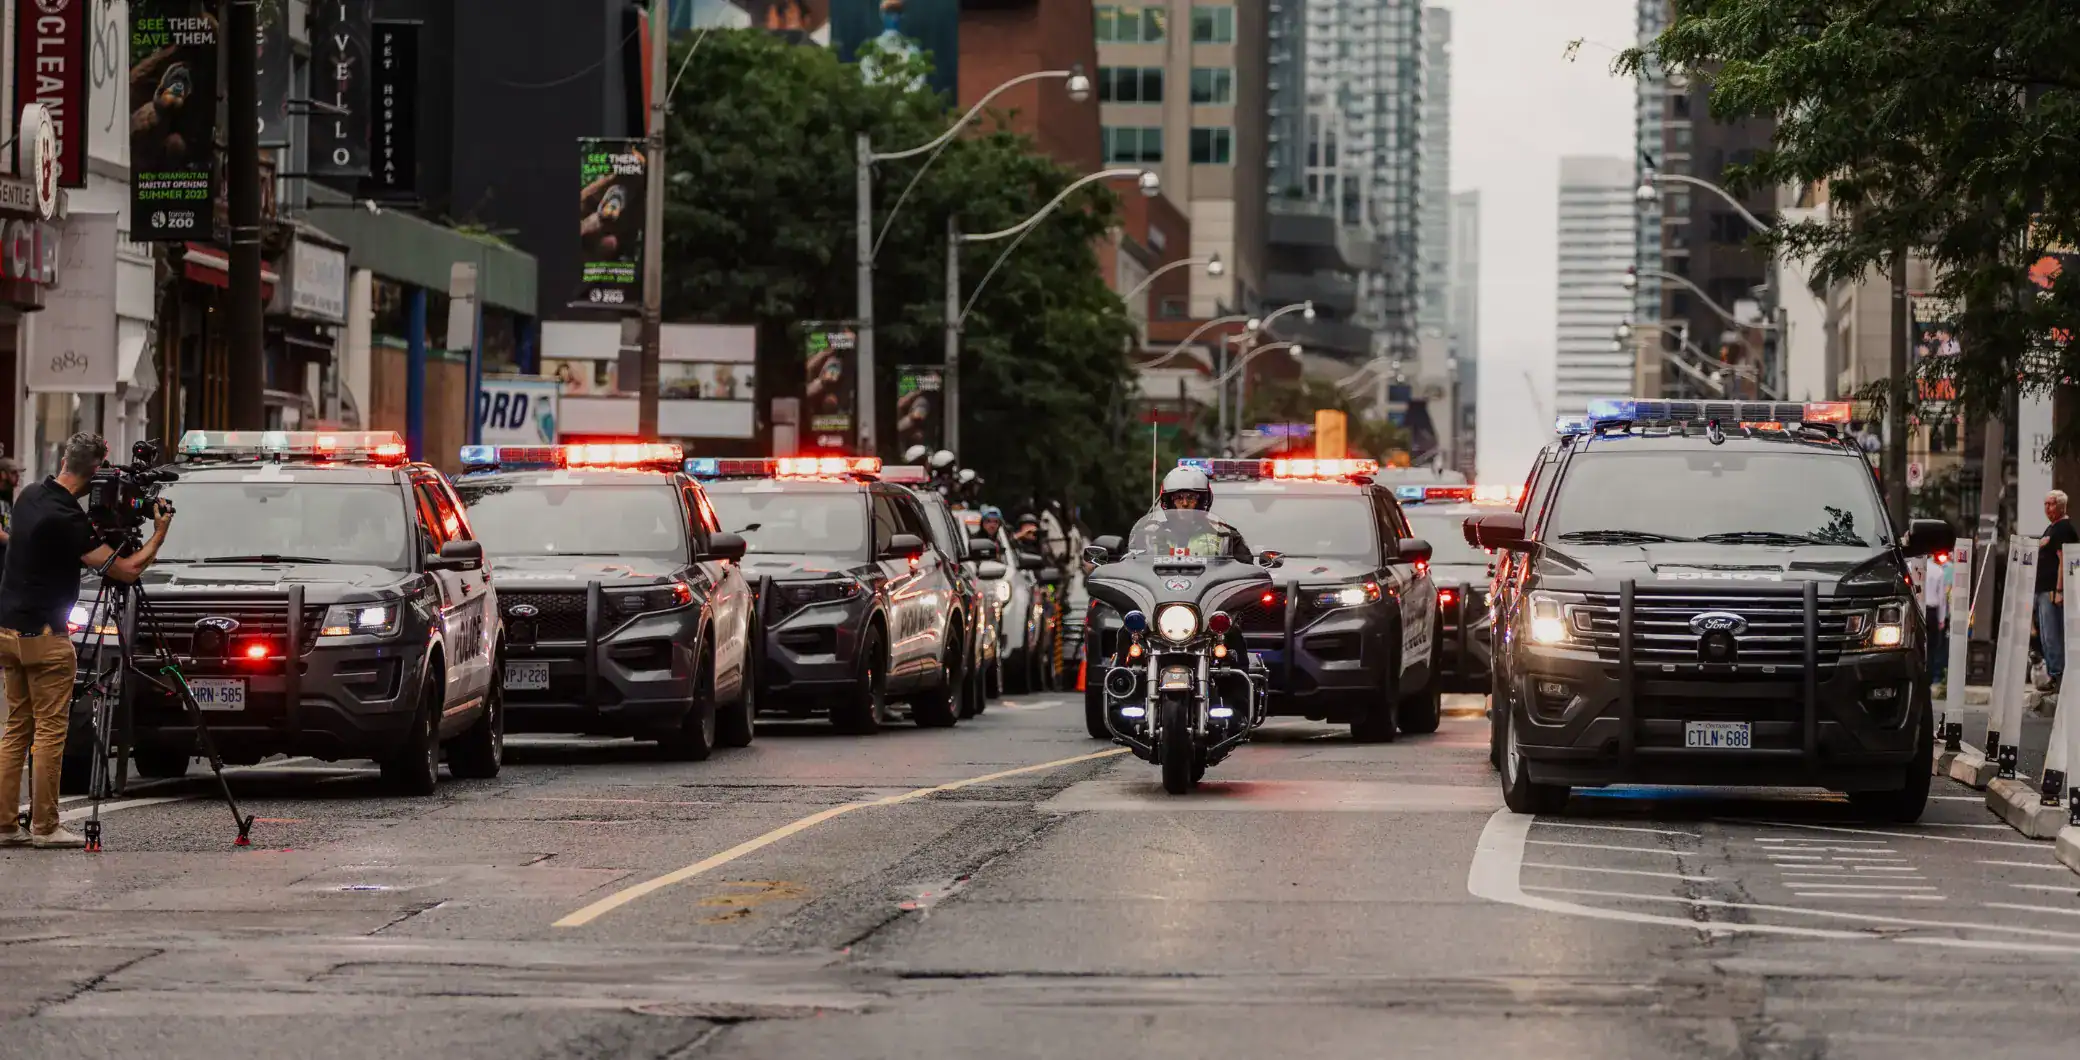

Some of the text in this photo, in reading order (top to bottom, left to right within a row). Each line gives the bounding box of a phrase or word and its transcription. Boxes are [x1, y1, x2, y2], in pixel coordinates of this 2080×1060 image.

[138, 17, 212, 30] SEE THEM.
[132, 32, 216, 45] SAVE THEM.
[383, 33, 395, 184] PET HOSPITAL
[138, 180, 208, 189] HABITAT OPENING
[0, 184, 31, 206] ENTLE
[138, 189, 208, 200] SUMMER 2023
[51, 350, 88, 373] 889
[1705, 618, 1733, 630] Ford
